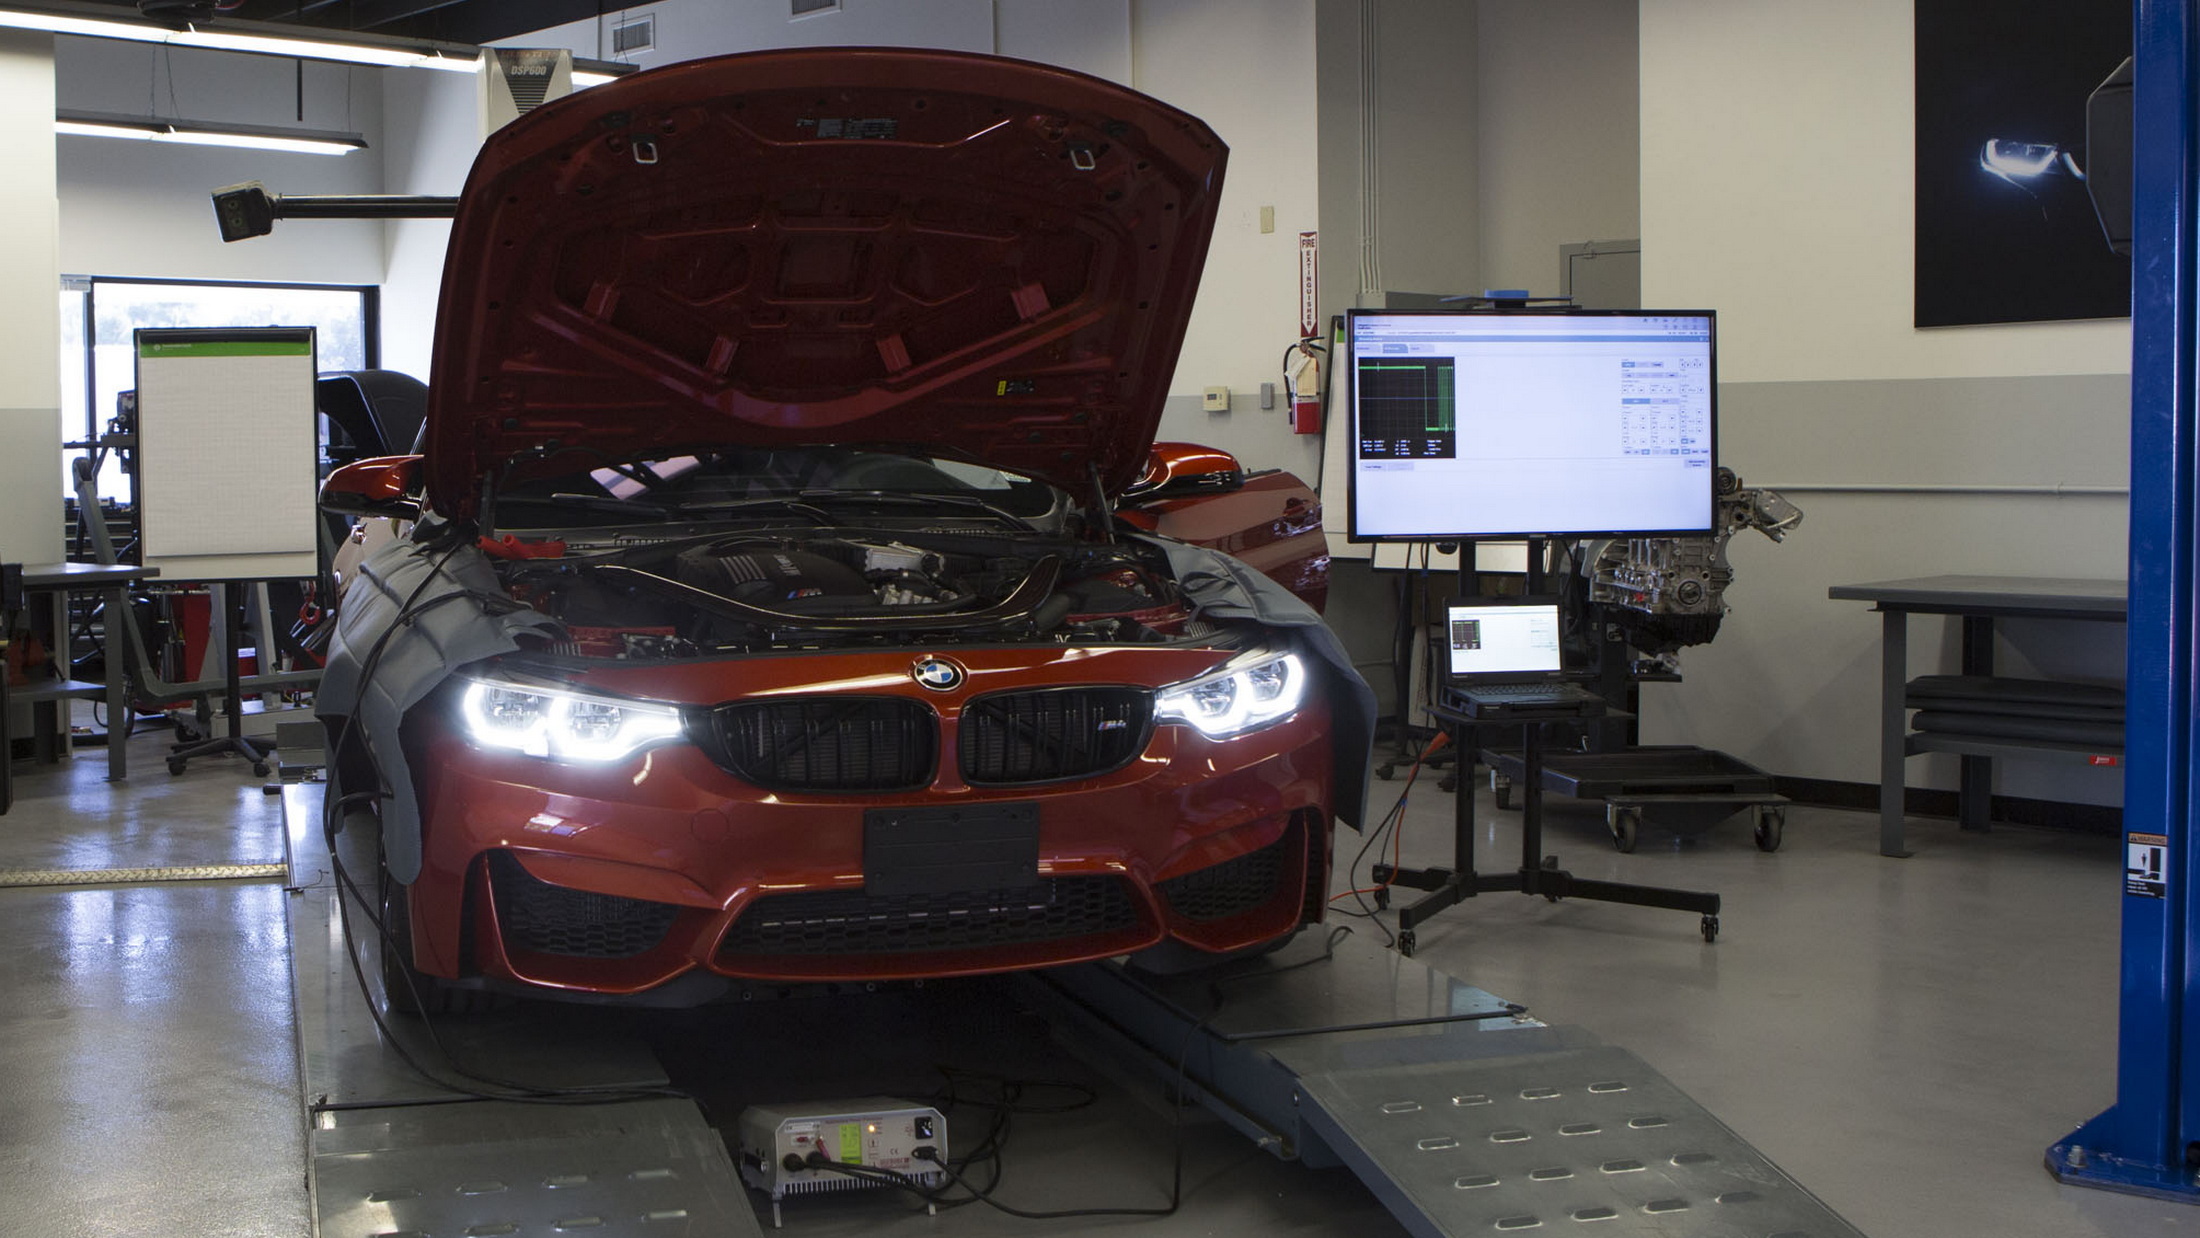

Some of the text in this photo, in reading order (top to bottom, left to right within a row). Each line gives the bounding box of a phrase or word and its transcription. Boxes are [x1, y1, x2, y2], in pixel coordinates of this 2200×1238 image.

[511, 65, 547, 76] DSP600
[1301, 238, 1316, 248] FIRE
[1305, 249, 1313, 327] EXTINGUISHER
